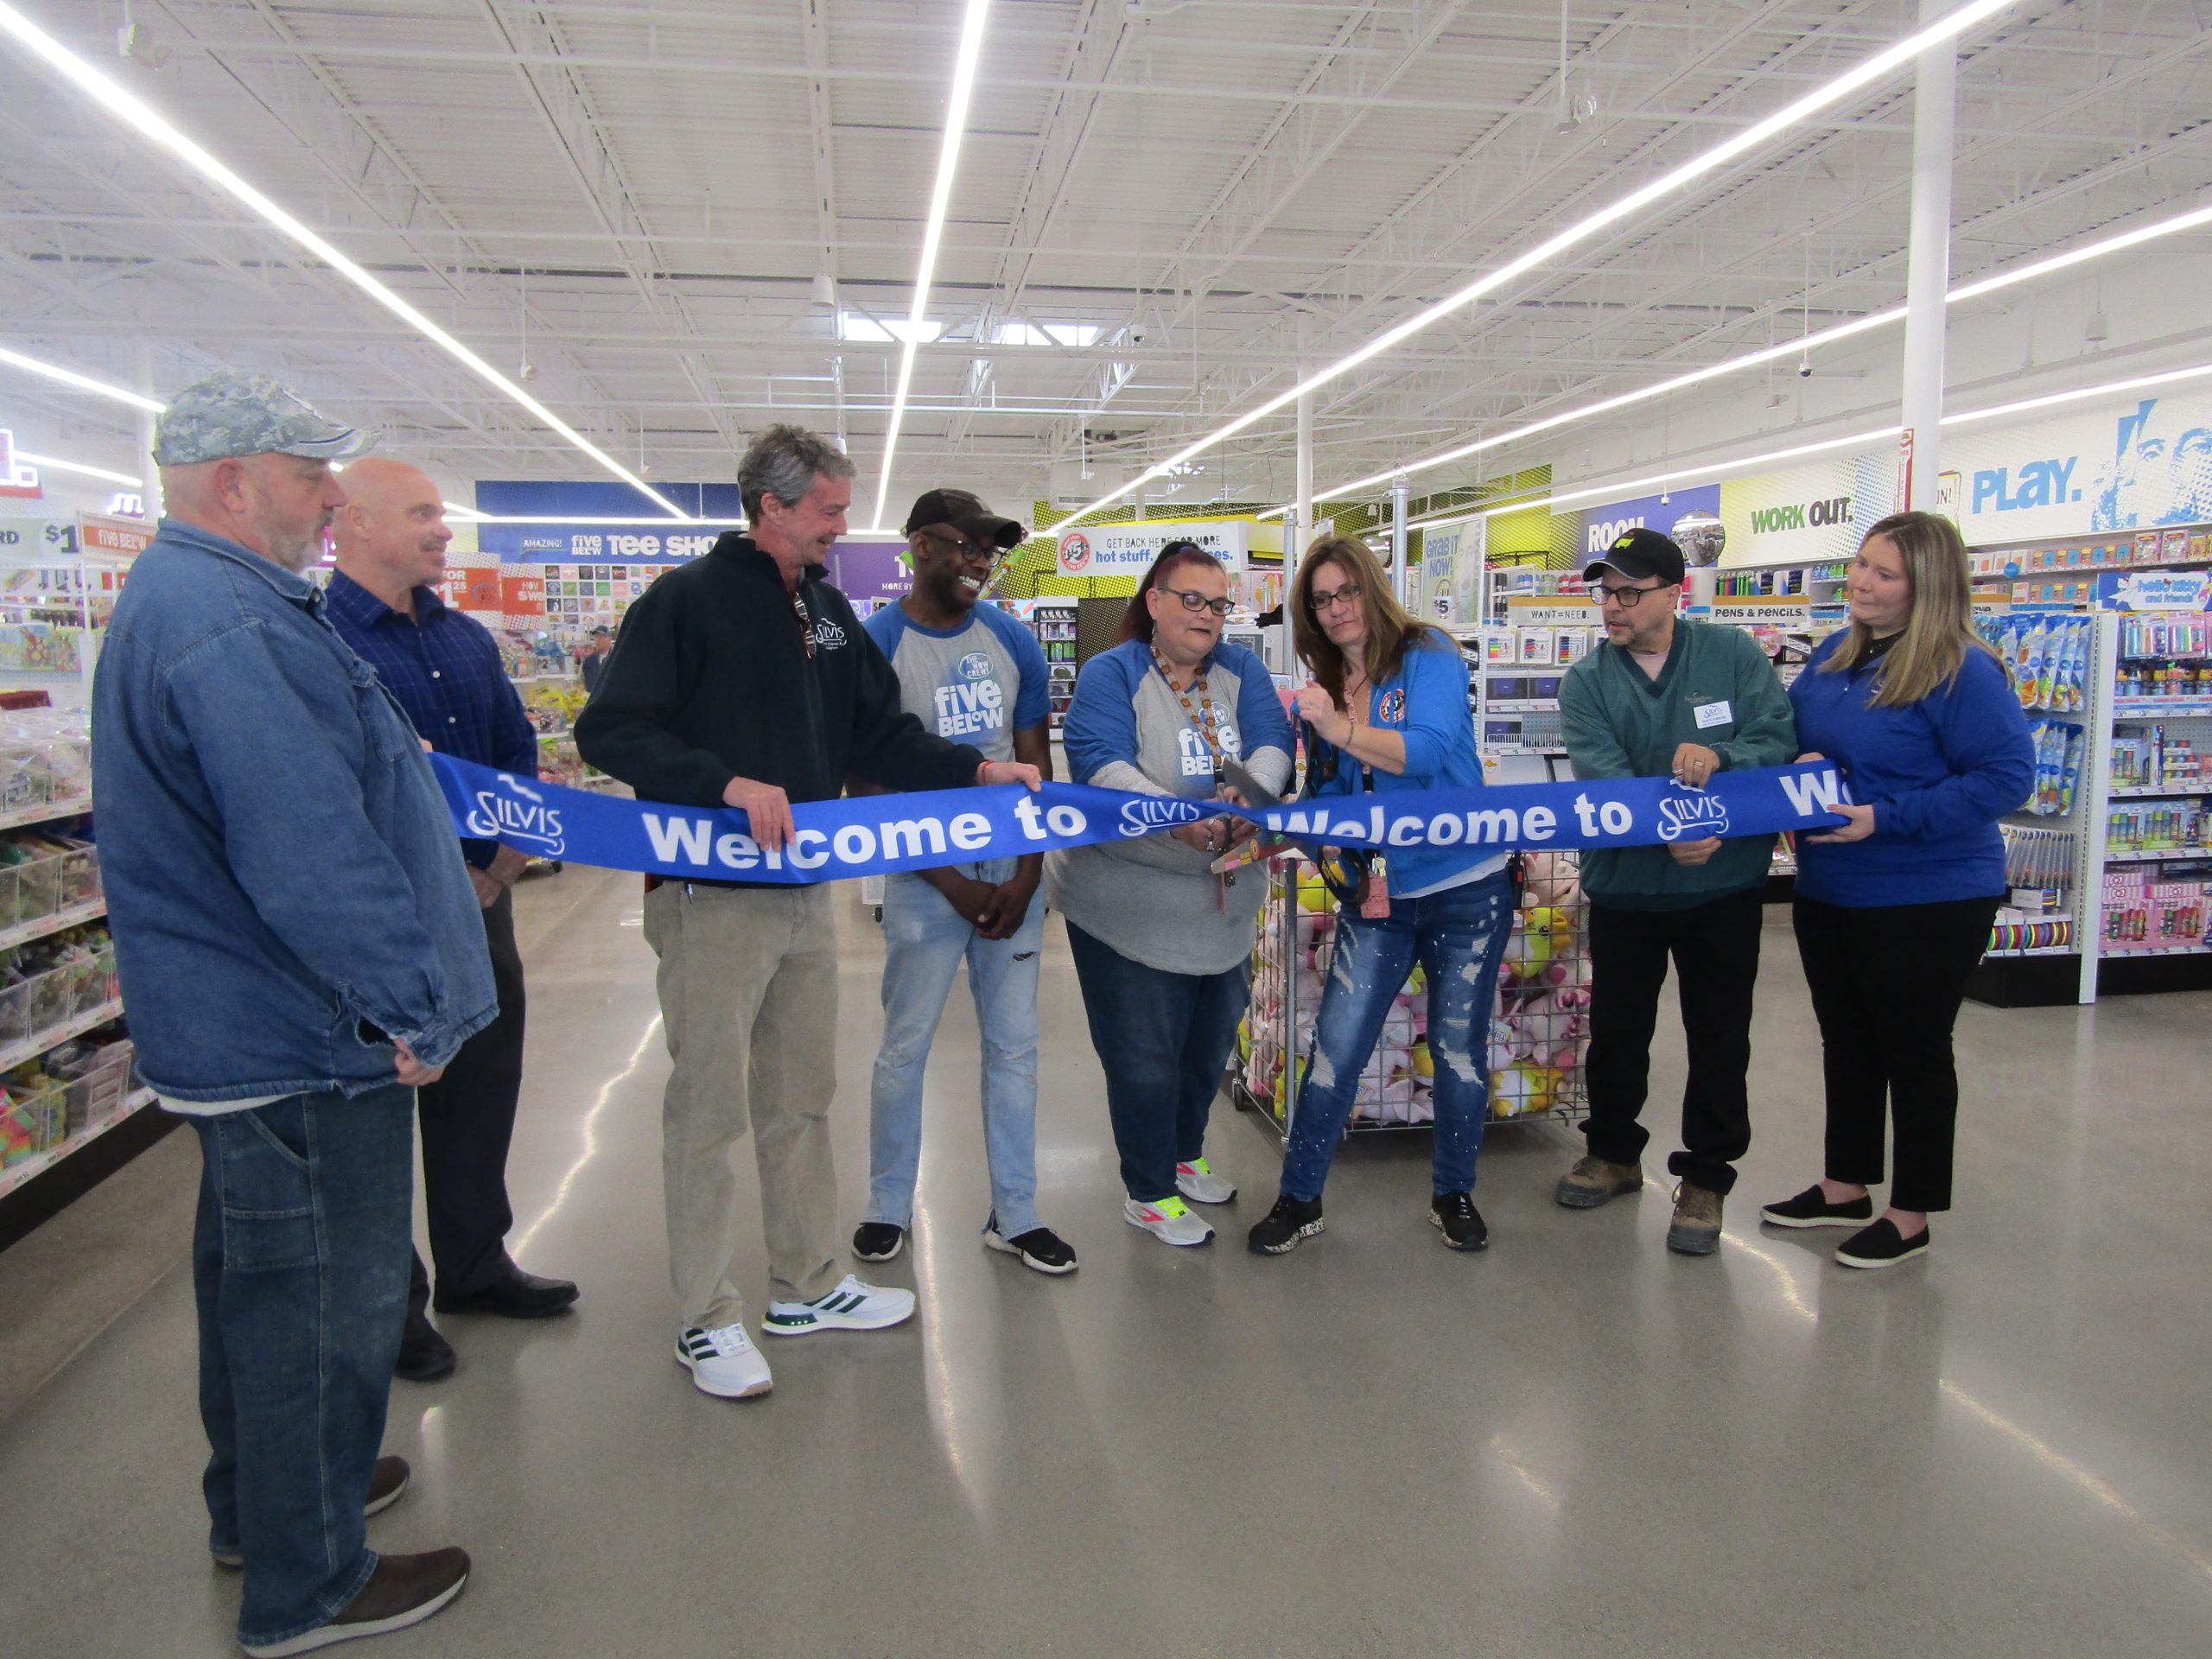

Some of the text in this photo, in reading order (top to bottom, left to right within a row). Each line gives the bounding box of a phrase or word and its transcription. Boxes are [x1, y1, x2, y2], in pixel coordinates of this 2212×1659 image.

[1751, 497, 1854, 534] WORK OUT.
[46, 524, 79, 553] $1
[524, 539, 563, 548] AMAZING!
[572, 534, 602, 547] five
[1107, 537, 1122, 549] GET
[1126, 537, 1146, 548] BACK
[1196, 535, 1221, 546] MORE
[572, 547, 602, 556] BELOW
[1096, 550, 1116, 563] hot
[1119, 549, 1154, 562] stuff.
[1429, 556, 1453, 578] NOW!
[1434, 600, 1449, 614] $5
[1747, 608, 1755, 617] &
[967, 668, 989, 677] CREW!
[973, 661, 988, 670] WOW
[934, 679, 1002, 717] five
[938, 707, 1003, 737] BELOW
[1178, 726, 1242, 756] fie
[467, 791, 564, 854] SILVIS
[1014, 794, 1087, 840] to
[1119, 798, 1199, 836] SILVIS
[1573, 792, 1632, 836] to
[1657, 795, 1728, 841] SILVIS
[1779, 770, 1853, 817] W
